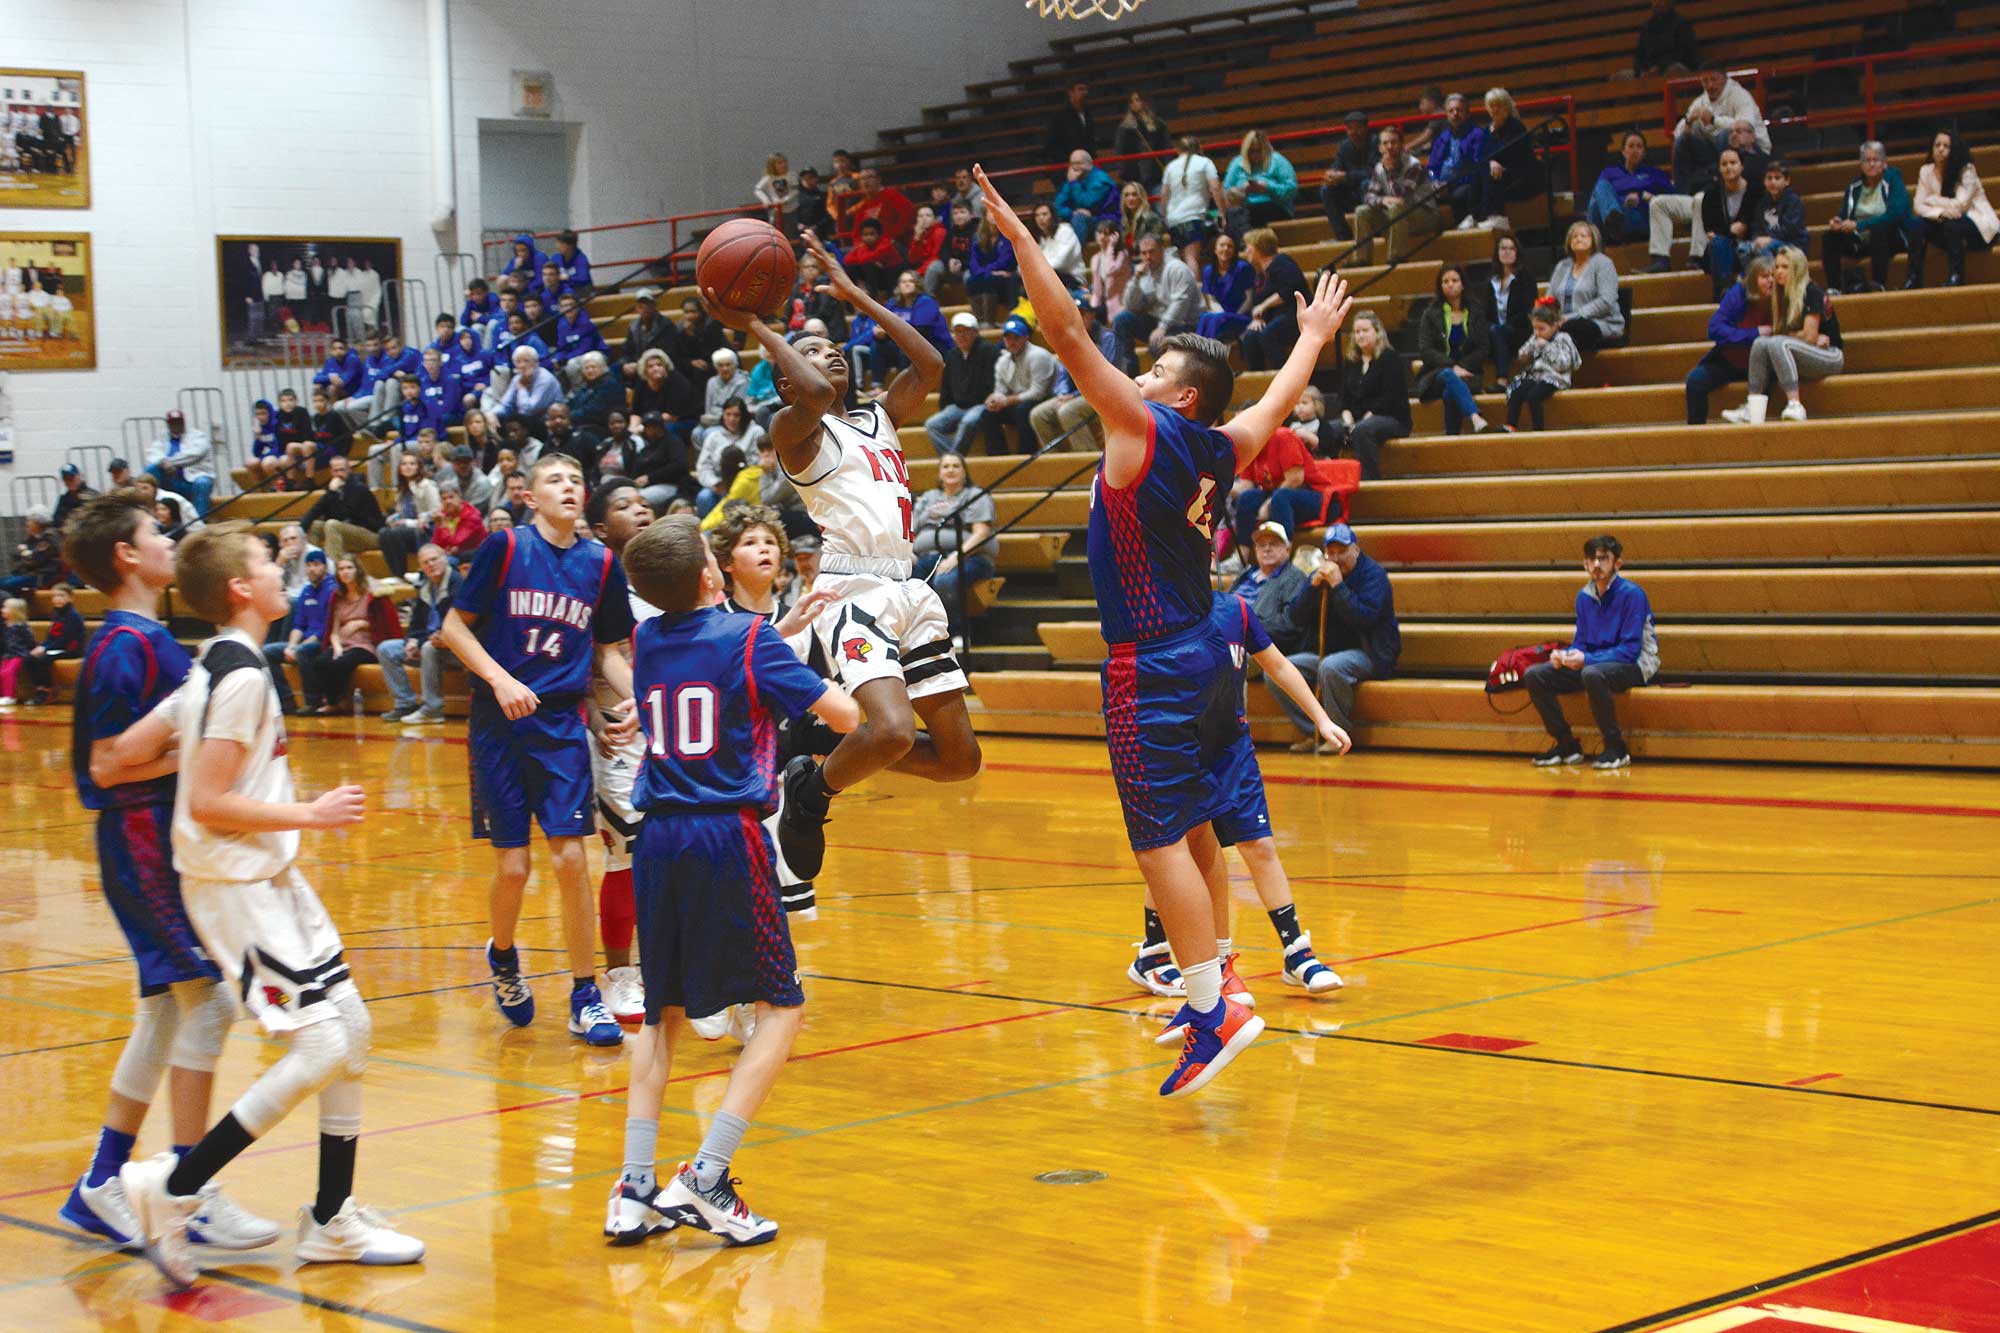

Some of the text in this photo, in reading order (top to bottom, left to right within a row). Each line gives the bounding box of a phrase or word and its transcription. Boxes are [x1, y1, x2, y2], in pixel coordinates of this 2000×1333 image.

[509, 589, 593, 631] INDIANS
[525, 627, 564, 659] 14
[643, 682, 720, 760] 10
